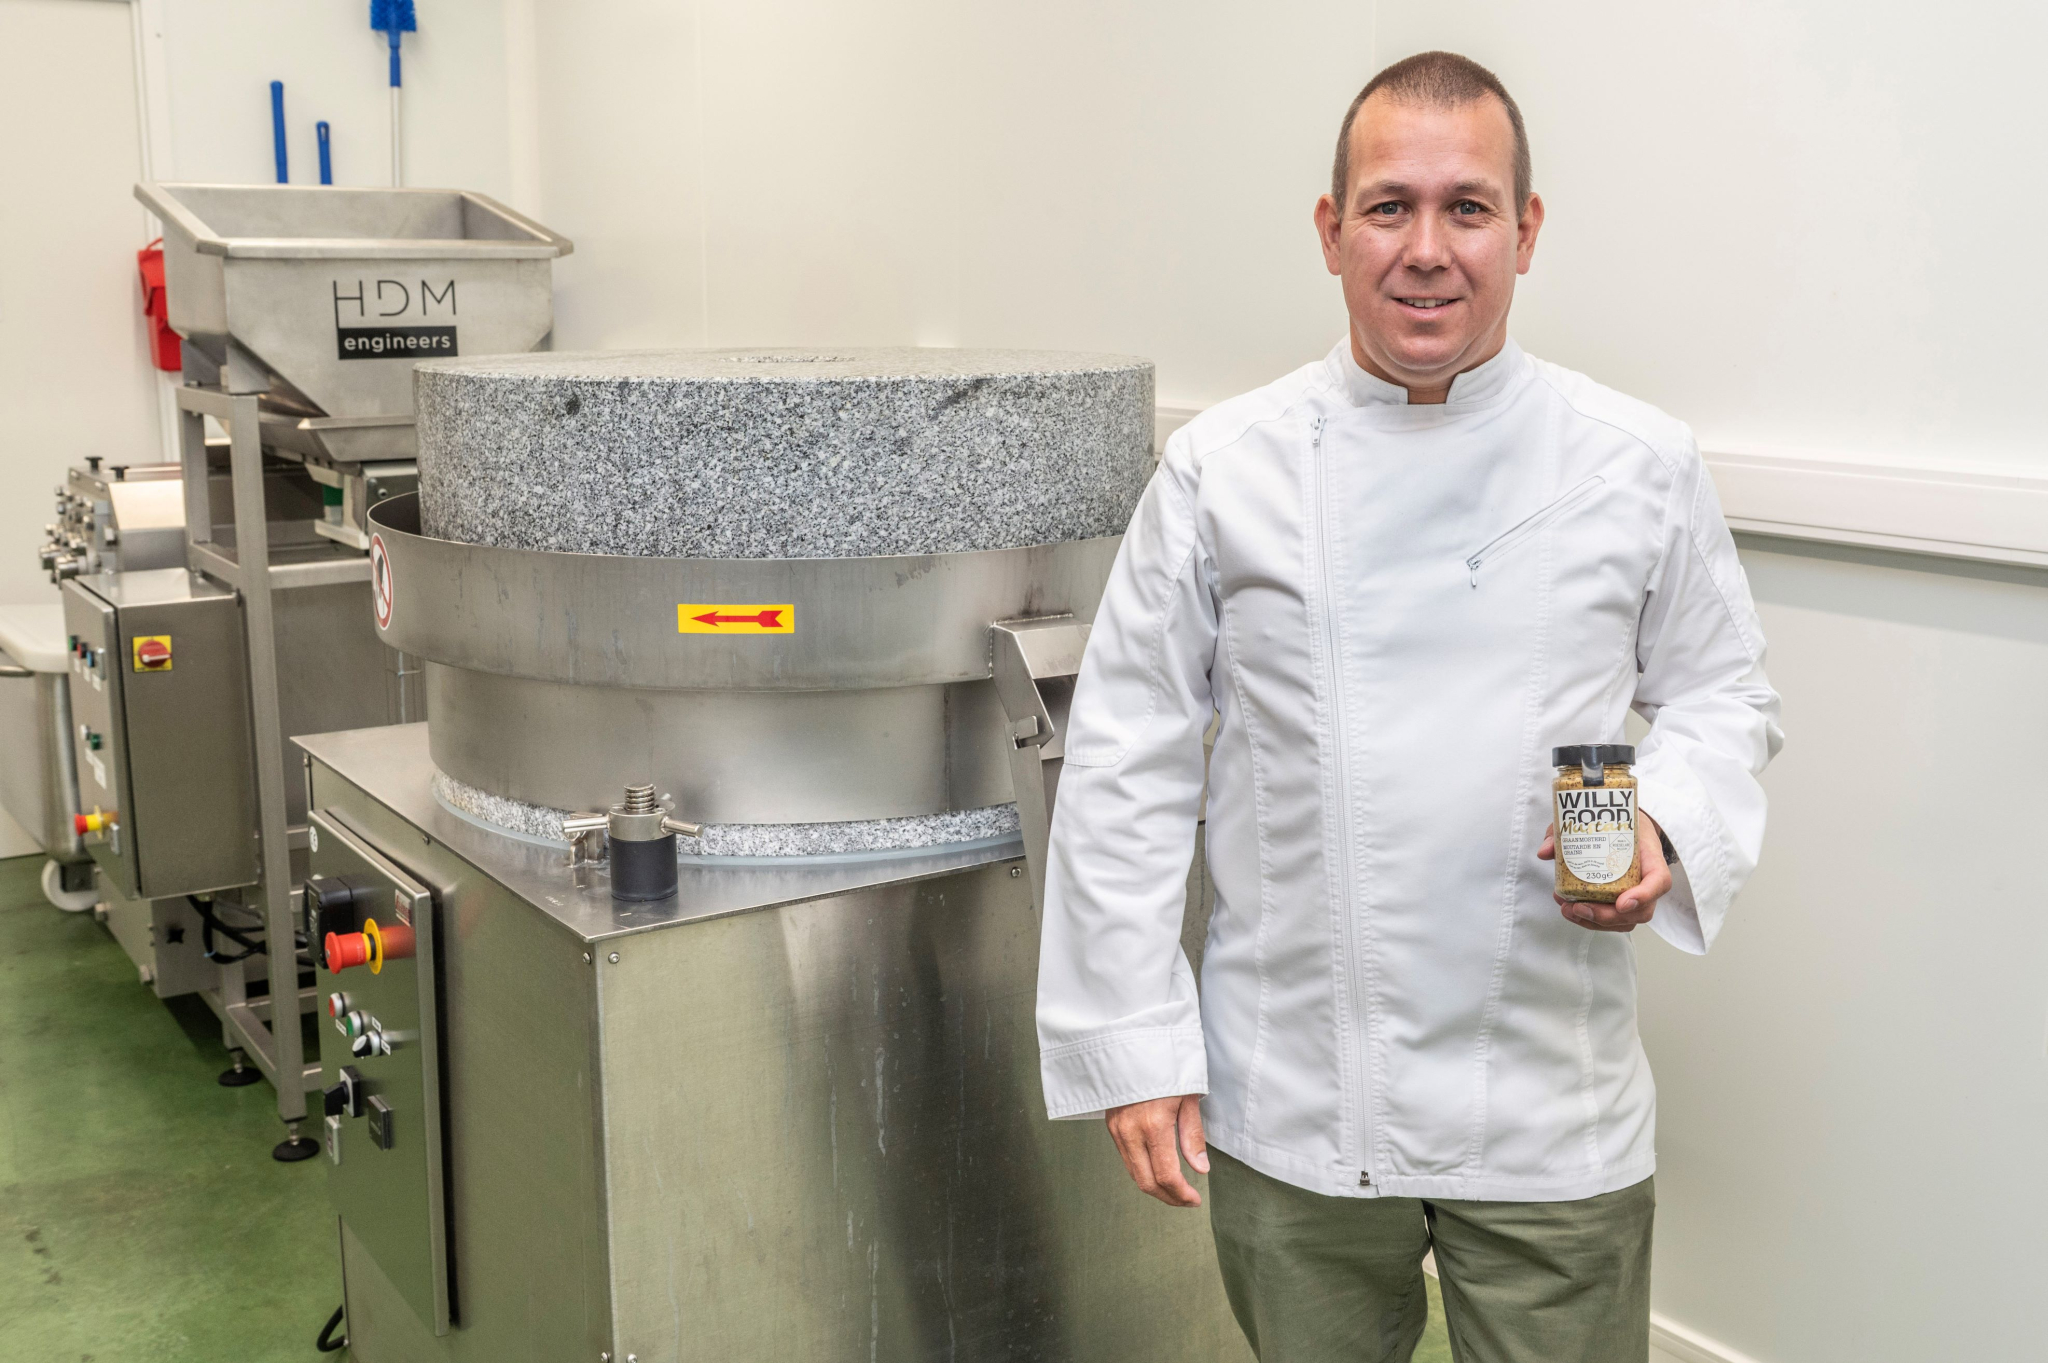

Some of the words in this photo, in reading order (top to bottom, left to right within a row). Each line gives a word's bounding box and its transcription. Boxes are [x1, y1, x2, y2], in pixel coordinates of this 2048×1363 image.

[333, 279, 457, 317] HDM
[344, 333, 451, 353] engineers
[1558, 790, 1632, 809] WILLY
[1559, 818, 1633, 834] Mustard
[1562, 808, 1630, 826] GOOD
